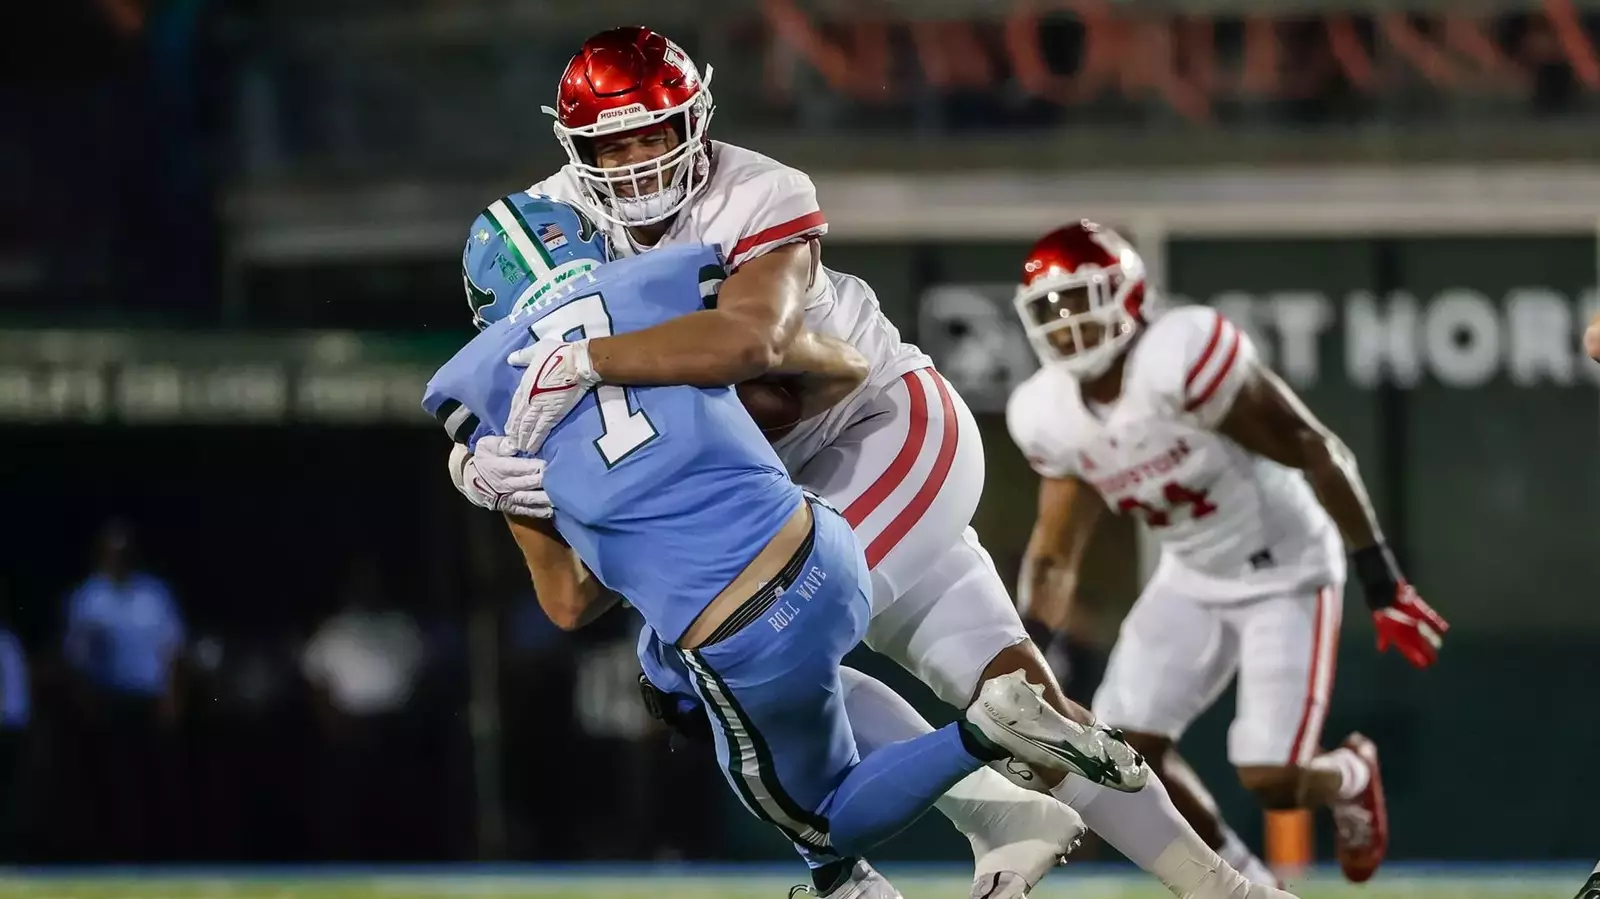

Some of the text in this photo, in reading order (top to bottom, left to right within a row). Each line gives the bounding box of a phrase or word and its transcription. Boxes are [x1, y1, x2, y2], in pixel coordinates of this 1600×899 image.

[600, 106, 641, 119] HOUSTON
[768, 566, 827, 633] ROLL WAVE
